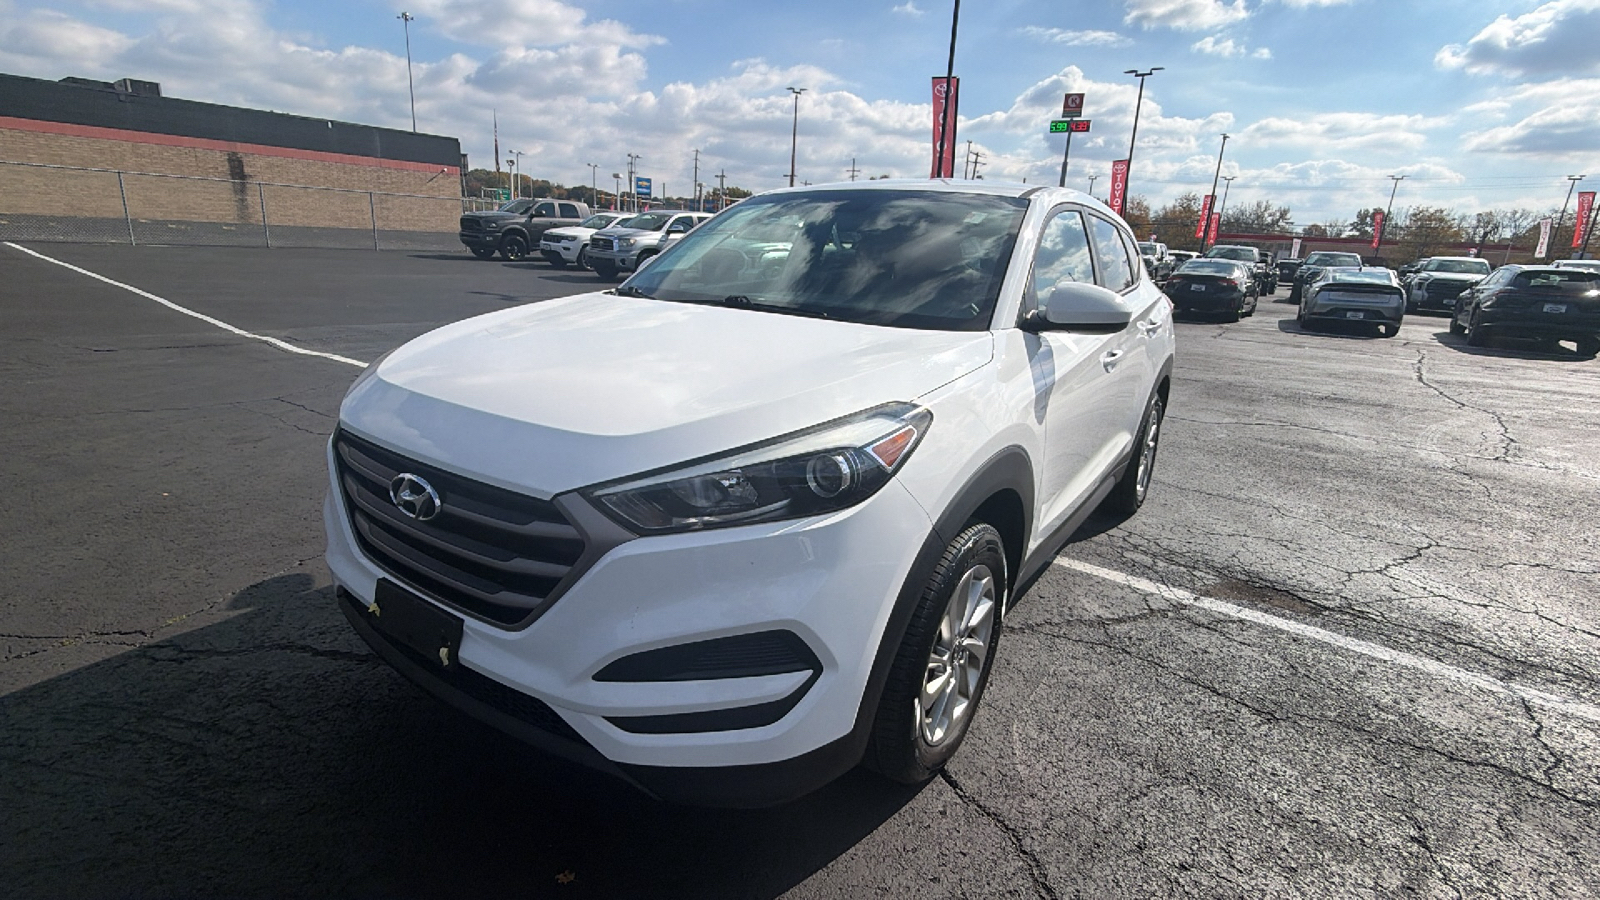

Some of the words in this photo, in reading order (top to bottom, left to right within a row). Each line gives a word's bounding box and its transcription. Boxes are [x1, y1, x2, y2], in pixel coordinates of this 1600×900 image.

[1051, 122, 1067, 132] 5.99
[1113, 174, 1122, 213] TOYOT
[1577, 203, 1588, 245] TOYOTA
